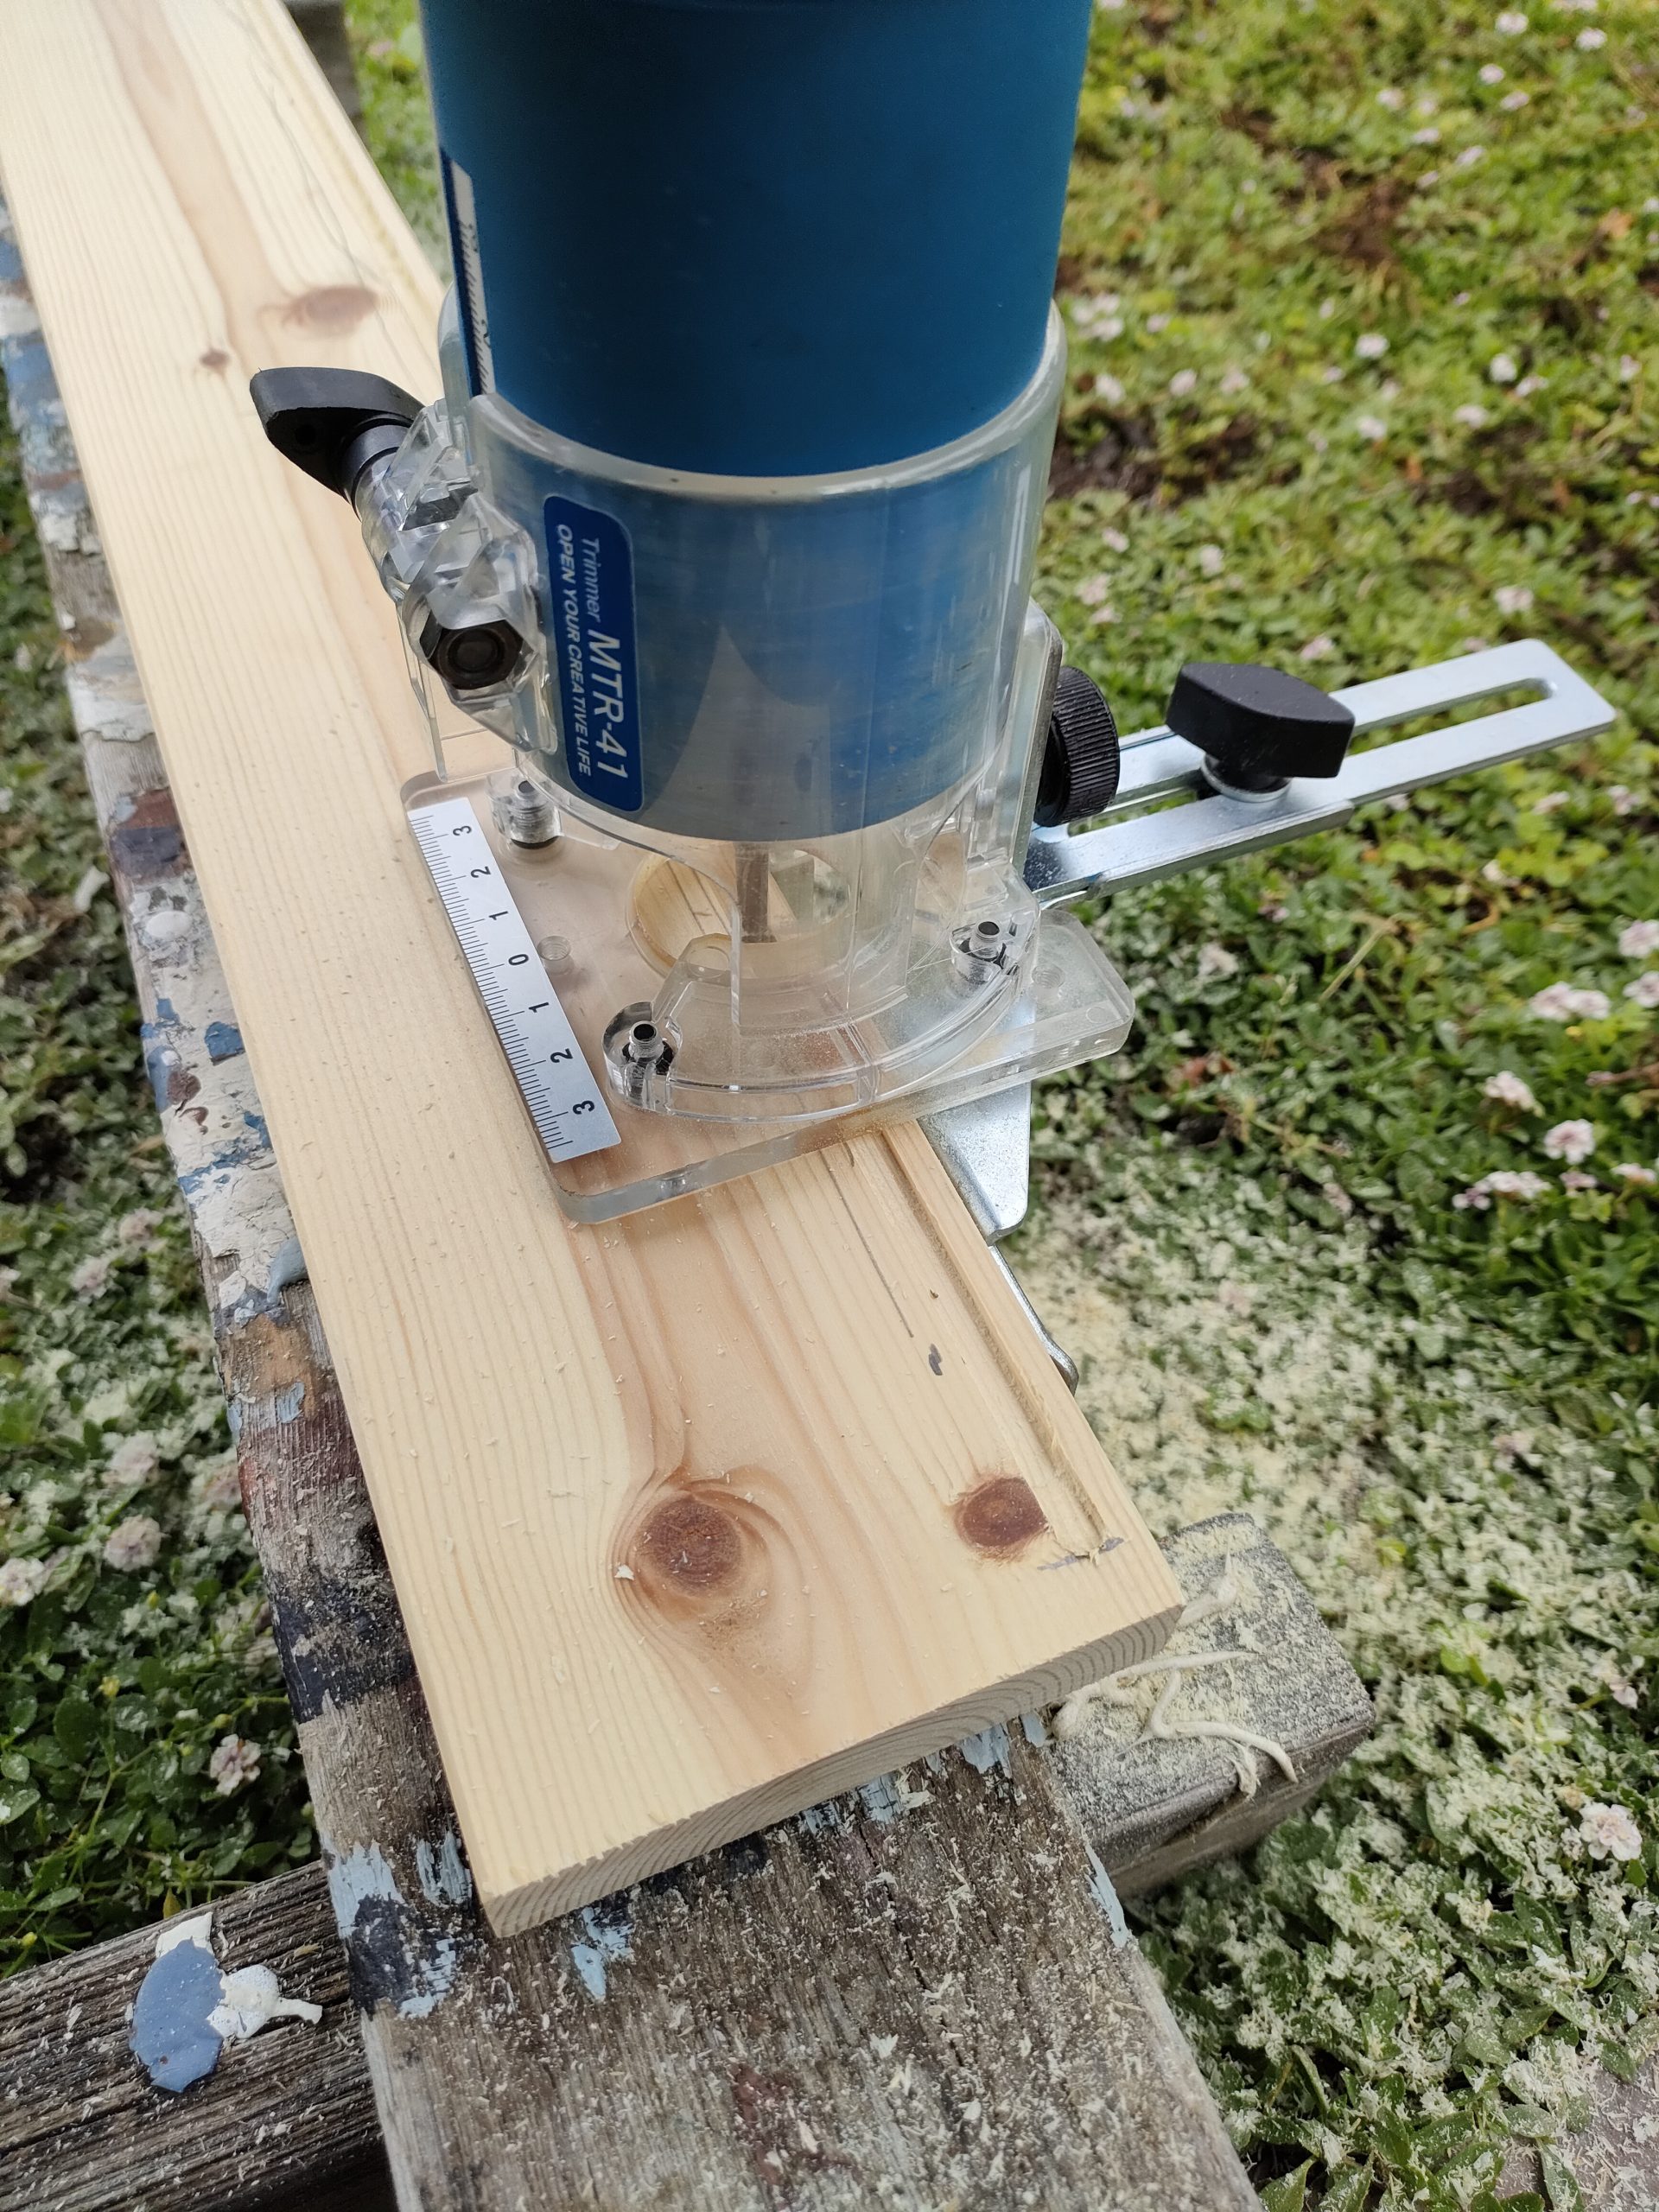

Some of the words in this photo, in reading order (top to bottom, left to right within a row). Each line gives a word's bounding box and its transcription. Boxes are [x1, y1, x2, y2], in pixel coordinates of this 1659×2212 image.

[556, 524, 577, 583] OPEN
[581, 537, 601, 623] Trimmer
[563, 588, 581, 643] YOUR
[569, 644, 589, 735] CREATIVE
[587, 628, 629, 779] MTR-41
[575, 737, 592, 777] LIFE
[452, 824, 473, 836] 3
[470, 866, 491, 879] 2
[488, 910, 509, 921] 1
[508, 953, 530, 966] 0
[528, 1001, 550, 1014] 1
[550, 1047, 574, 1064] 2
[572, 1099, 595, 1116] 3
